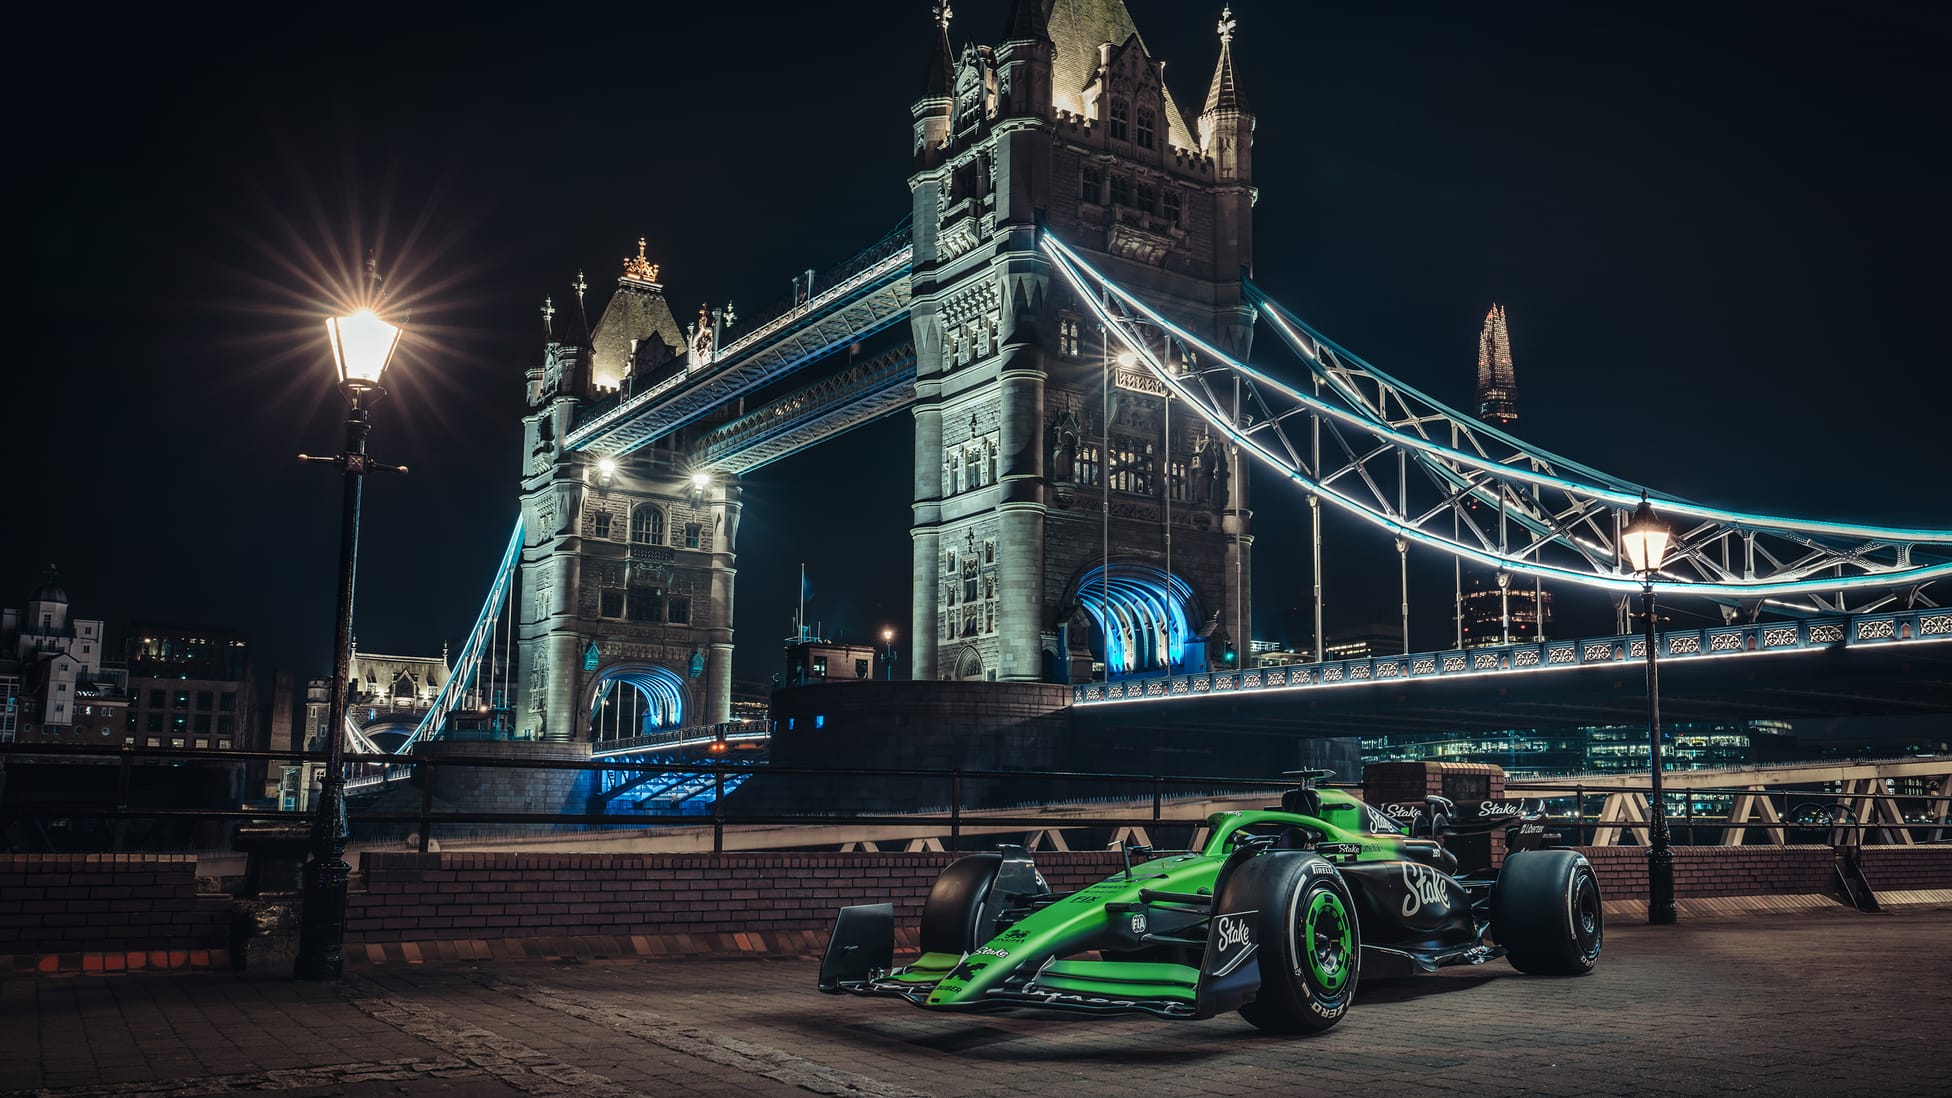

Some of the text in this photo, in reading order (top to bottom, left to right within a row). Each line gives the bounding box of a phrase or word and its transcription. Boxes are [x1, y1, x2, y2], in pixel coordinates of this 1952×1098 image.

[1386, 804, 1422, 818] Stake
[1478, 801, 1517, 816] Stake
[1338, 844, 1360, 854] Stake
[1401, 862, 1450, 916] Stake
[1218, 917, 1249, 952] Stake
[1311, 1001, 1345, 1019] ZERO
